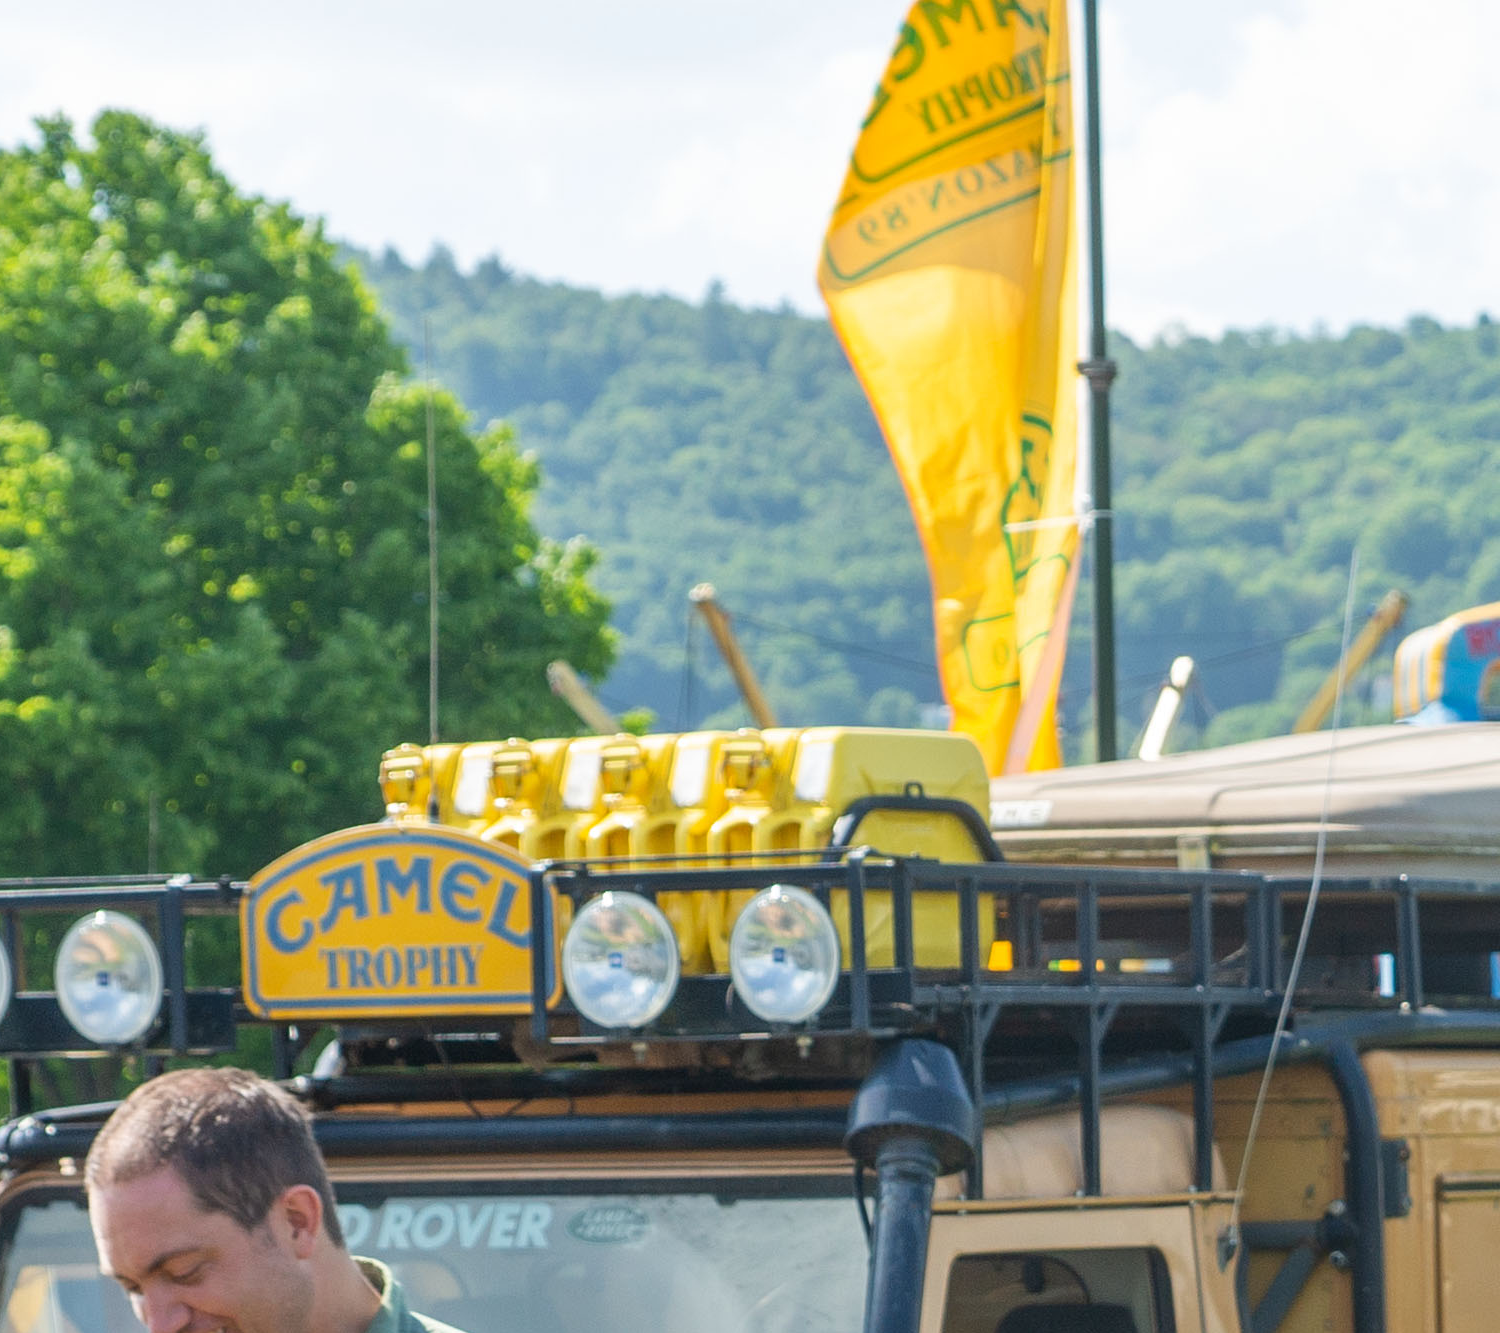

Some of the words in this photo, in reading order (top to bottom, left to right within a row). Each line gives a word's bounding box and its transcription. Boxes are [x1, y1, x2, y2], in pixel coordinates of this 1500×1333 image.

[265, 856, 532, 955] CAMEL
[318, 943, 485, 989] TROPHY
[376, 1202, 552, 1249] ROVER
